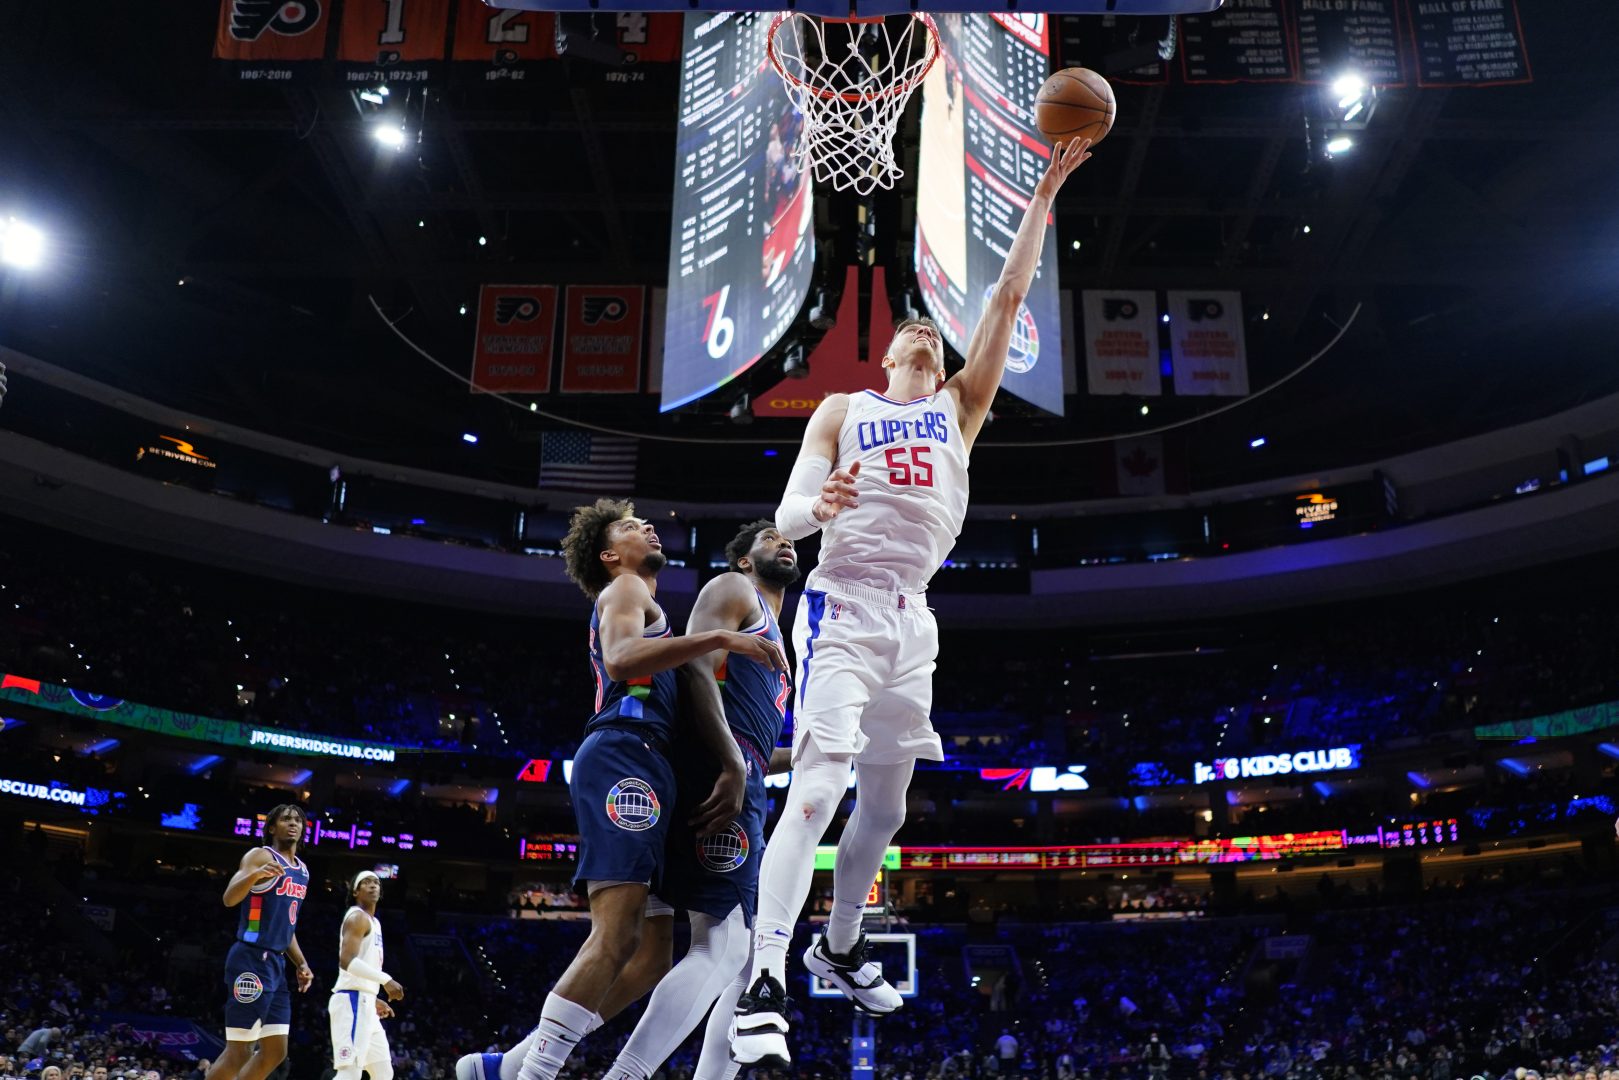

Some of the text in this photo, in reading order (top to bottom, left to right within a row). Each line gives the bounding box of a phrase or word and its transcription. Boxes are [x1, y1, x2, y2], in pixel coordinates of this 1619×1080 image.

[858, 411, 948, 452] CLIPPERS
[885, 446, 933, 487] 55
[250, 730, 395, 762] JR76ERSKIDSCLUB.COM
[1241, 753, 1293, 778] KIDS
[1292, 748, 1352, 772] CLUB
[527, 843, 553, 852] PLAYER
[289, 901, 298, 925] 0
